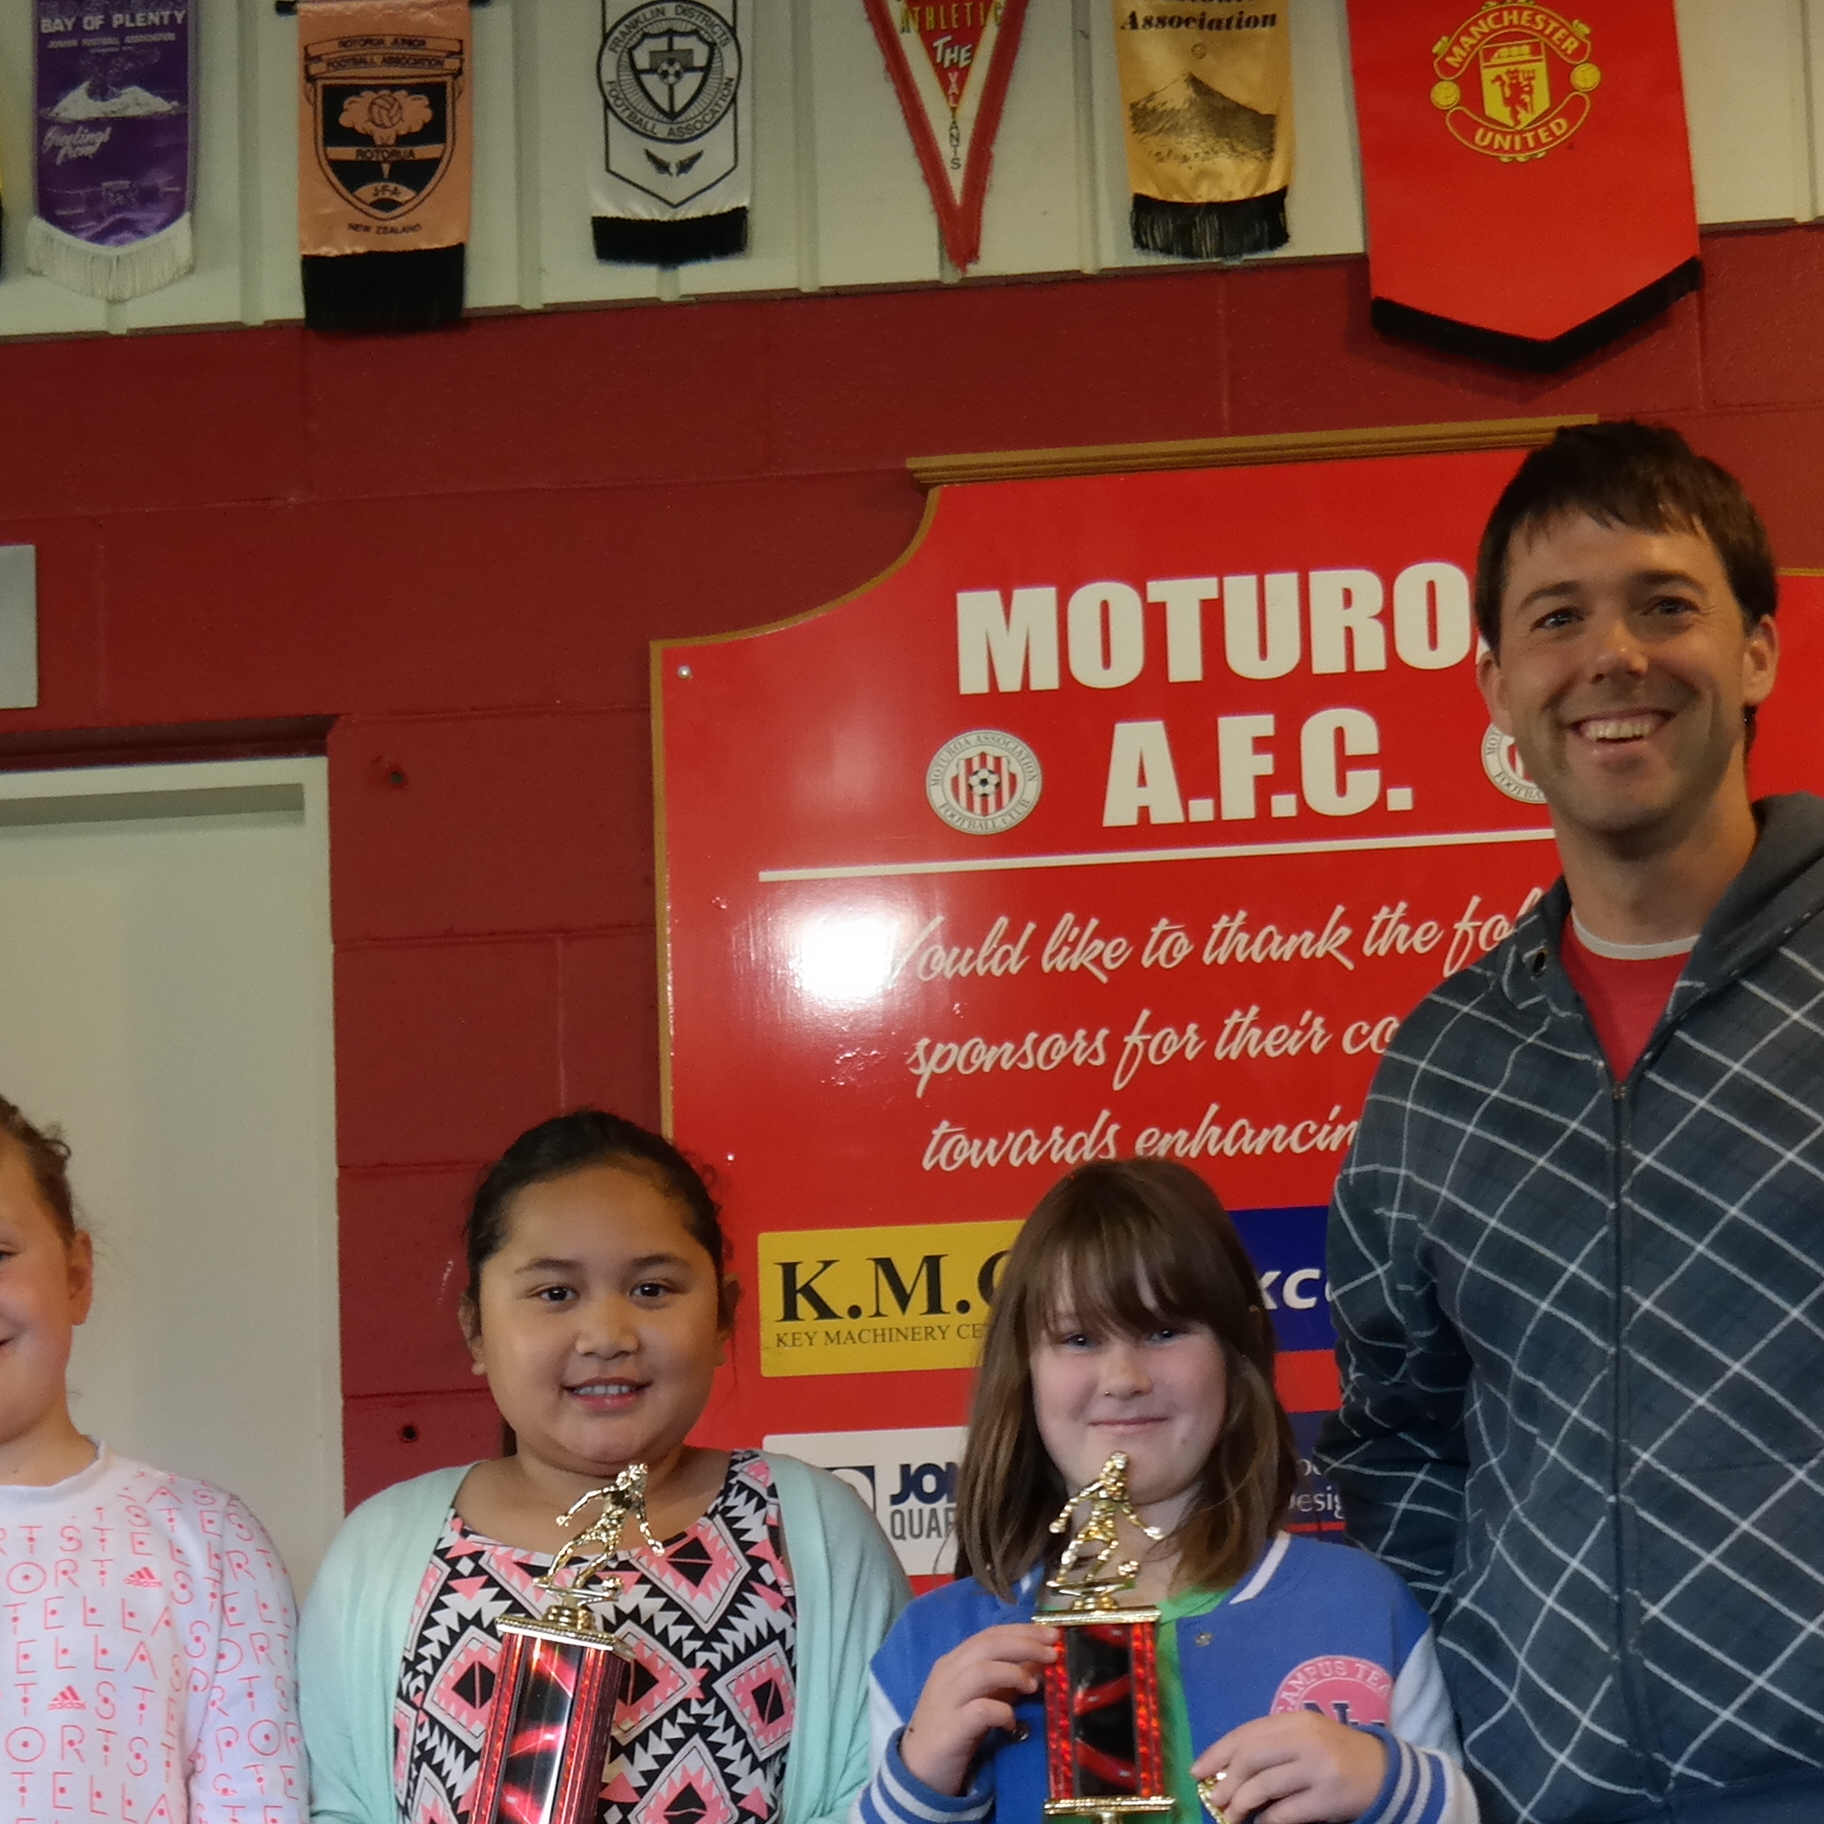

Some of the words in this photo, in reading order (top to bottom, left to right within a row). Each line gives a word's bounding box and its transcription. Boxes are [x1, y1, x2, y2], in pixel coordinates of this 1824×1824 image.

[40, 17, 76, 33] BAY
[82, 15, 105, 31] OF
[112, 9, 187, 29] PLENTY
[608, 6, 666, 55] FRANKLIN
[675, 4, 732, 49] DISTRICTS
[1120, 10, 1278, 32] Association
[1445, 10, 1580, 68] MANCHESTER
[932, 35, 973, 69] THE
[605, 80, 658, 136] FOOTBALL
[355, 148, 416, 162] ROTORUA
[1474, 117, 1569, 151] UNITED
[347, 222, 372, 234] NEW
[376, 223, 422, 235] ZEALAND
[956, 562, 1489, 695] MOTURO
[930, 738, 972, 787] MOTUROA
[975, 734, 1037, 782] ASSOCIATION
[1102, 708, 1414, 827] A.F.C.
[1002, 798, 1031, 826] CLUB
[1041, 912, 1133, 983] like
[1140, 916, 1195, 969] to
[1201, 909, 1355, 971] thank
[1360, 901, 1445, 957] the
[906, 1024, 1110, 1098] sponsors
[1112, 1008, 1207, 1091] for
[1213, 1004, 1332, 1060] their
[921, 1109, 1122, 1172] towards
[775, 1331, 818, 1348] KEY
[824, 1325, 951, 1346] MACHINERY
